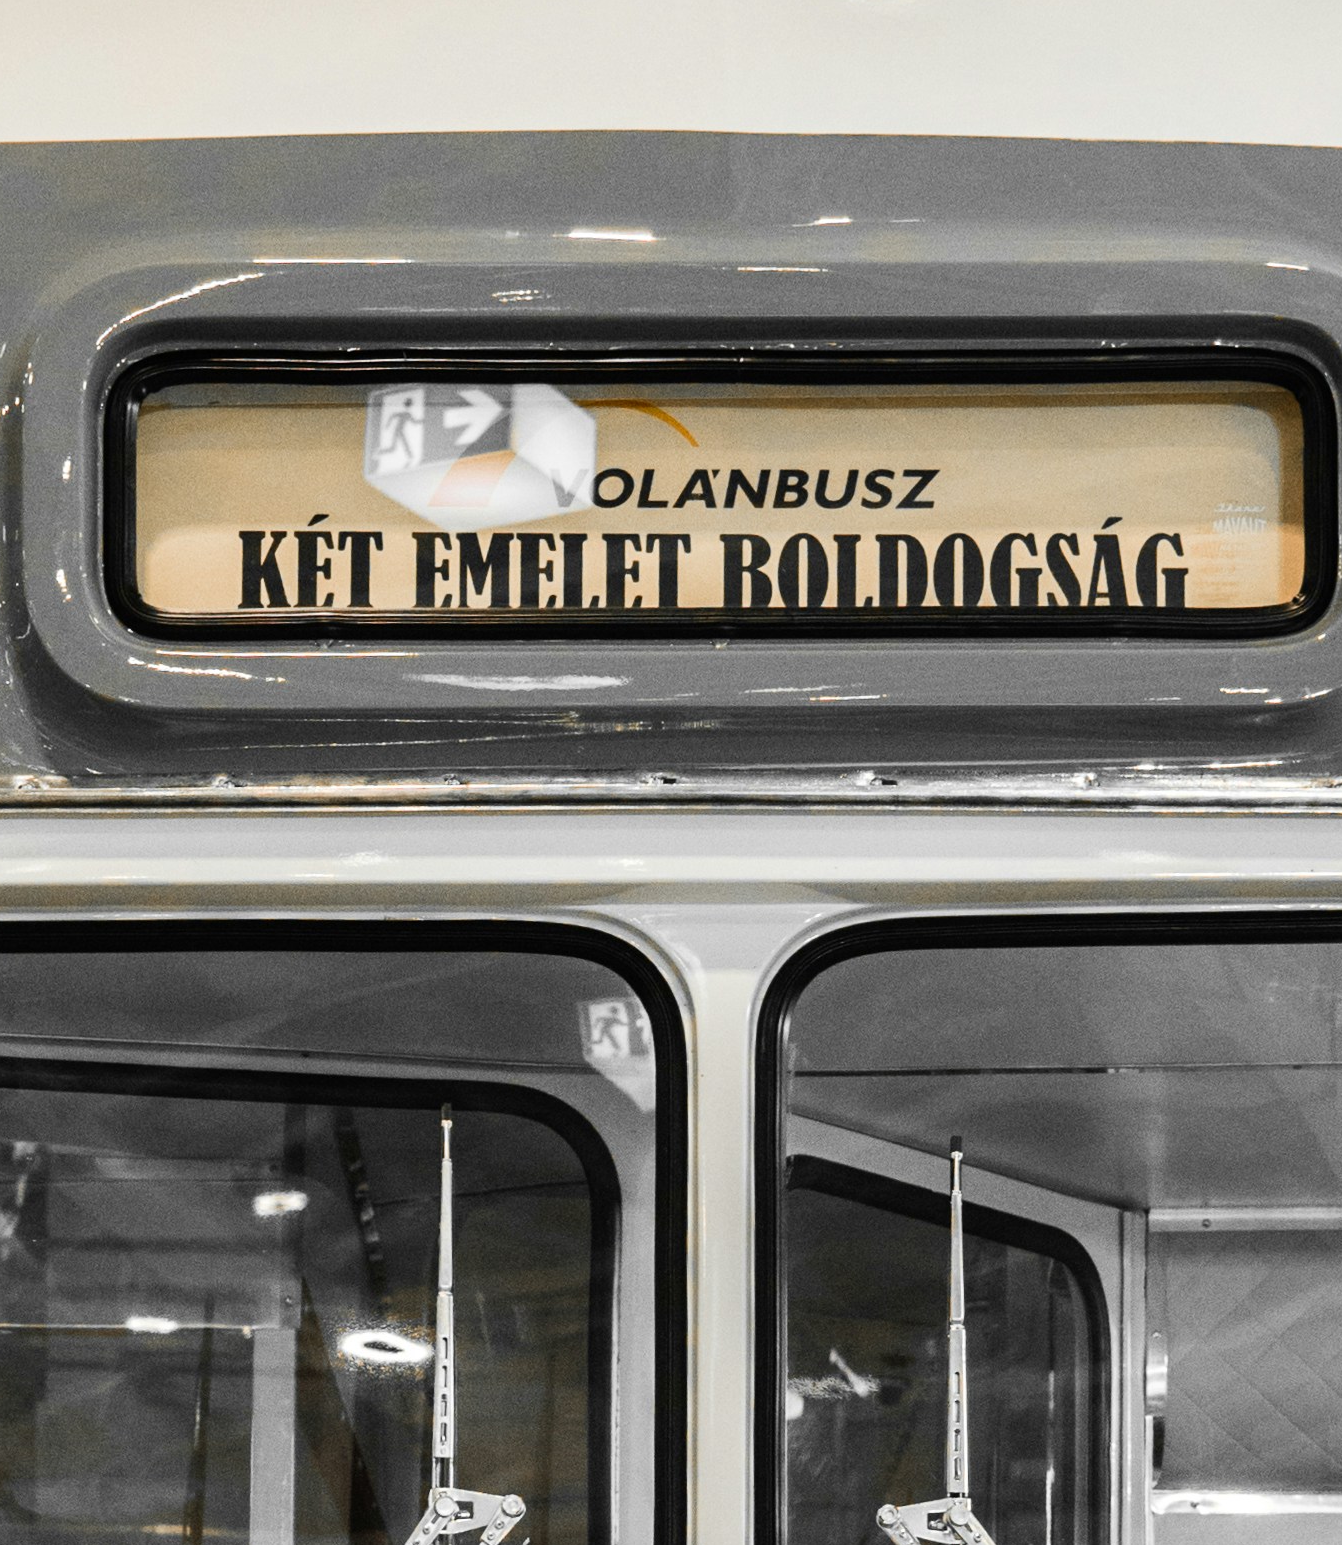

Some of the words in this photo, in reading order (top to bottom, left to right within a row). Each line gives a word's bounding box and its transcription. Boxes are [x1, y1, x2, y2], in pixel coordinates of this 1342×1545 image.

[551, 468, 940, 510] VOLÁNBUSZ
[238, 514, 383, 609] KÉT
[412, 531, 692, 609] EMELET
[719, 516, 1190, 608] BOLDOGSÁG
